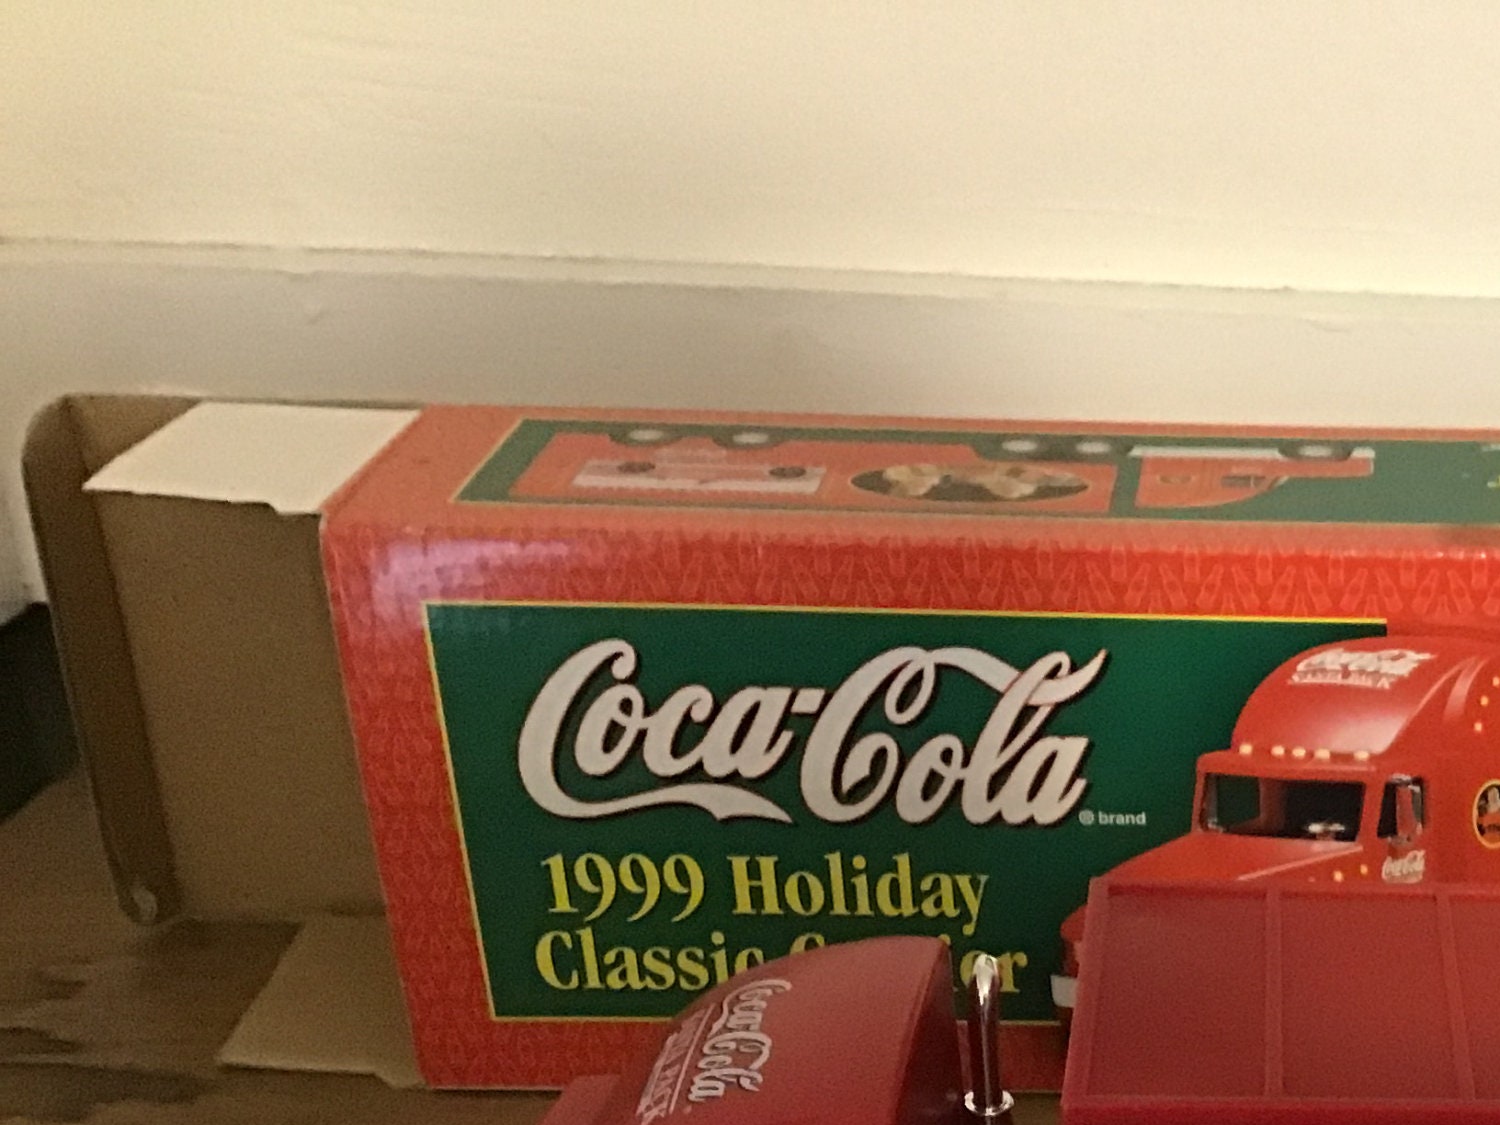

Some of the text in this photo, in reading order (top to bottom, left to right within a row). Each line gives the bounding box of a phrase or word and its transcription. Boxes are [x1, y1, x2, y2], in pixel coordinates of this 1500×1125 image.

[517, 638, 1110, 825] Coca-Cola
[1098, 810, 1147, 825] brand
[541, 852, 991, 929] 1999 Holiday
